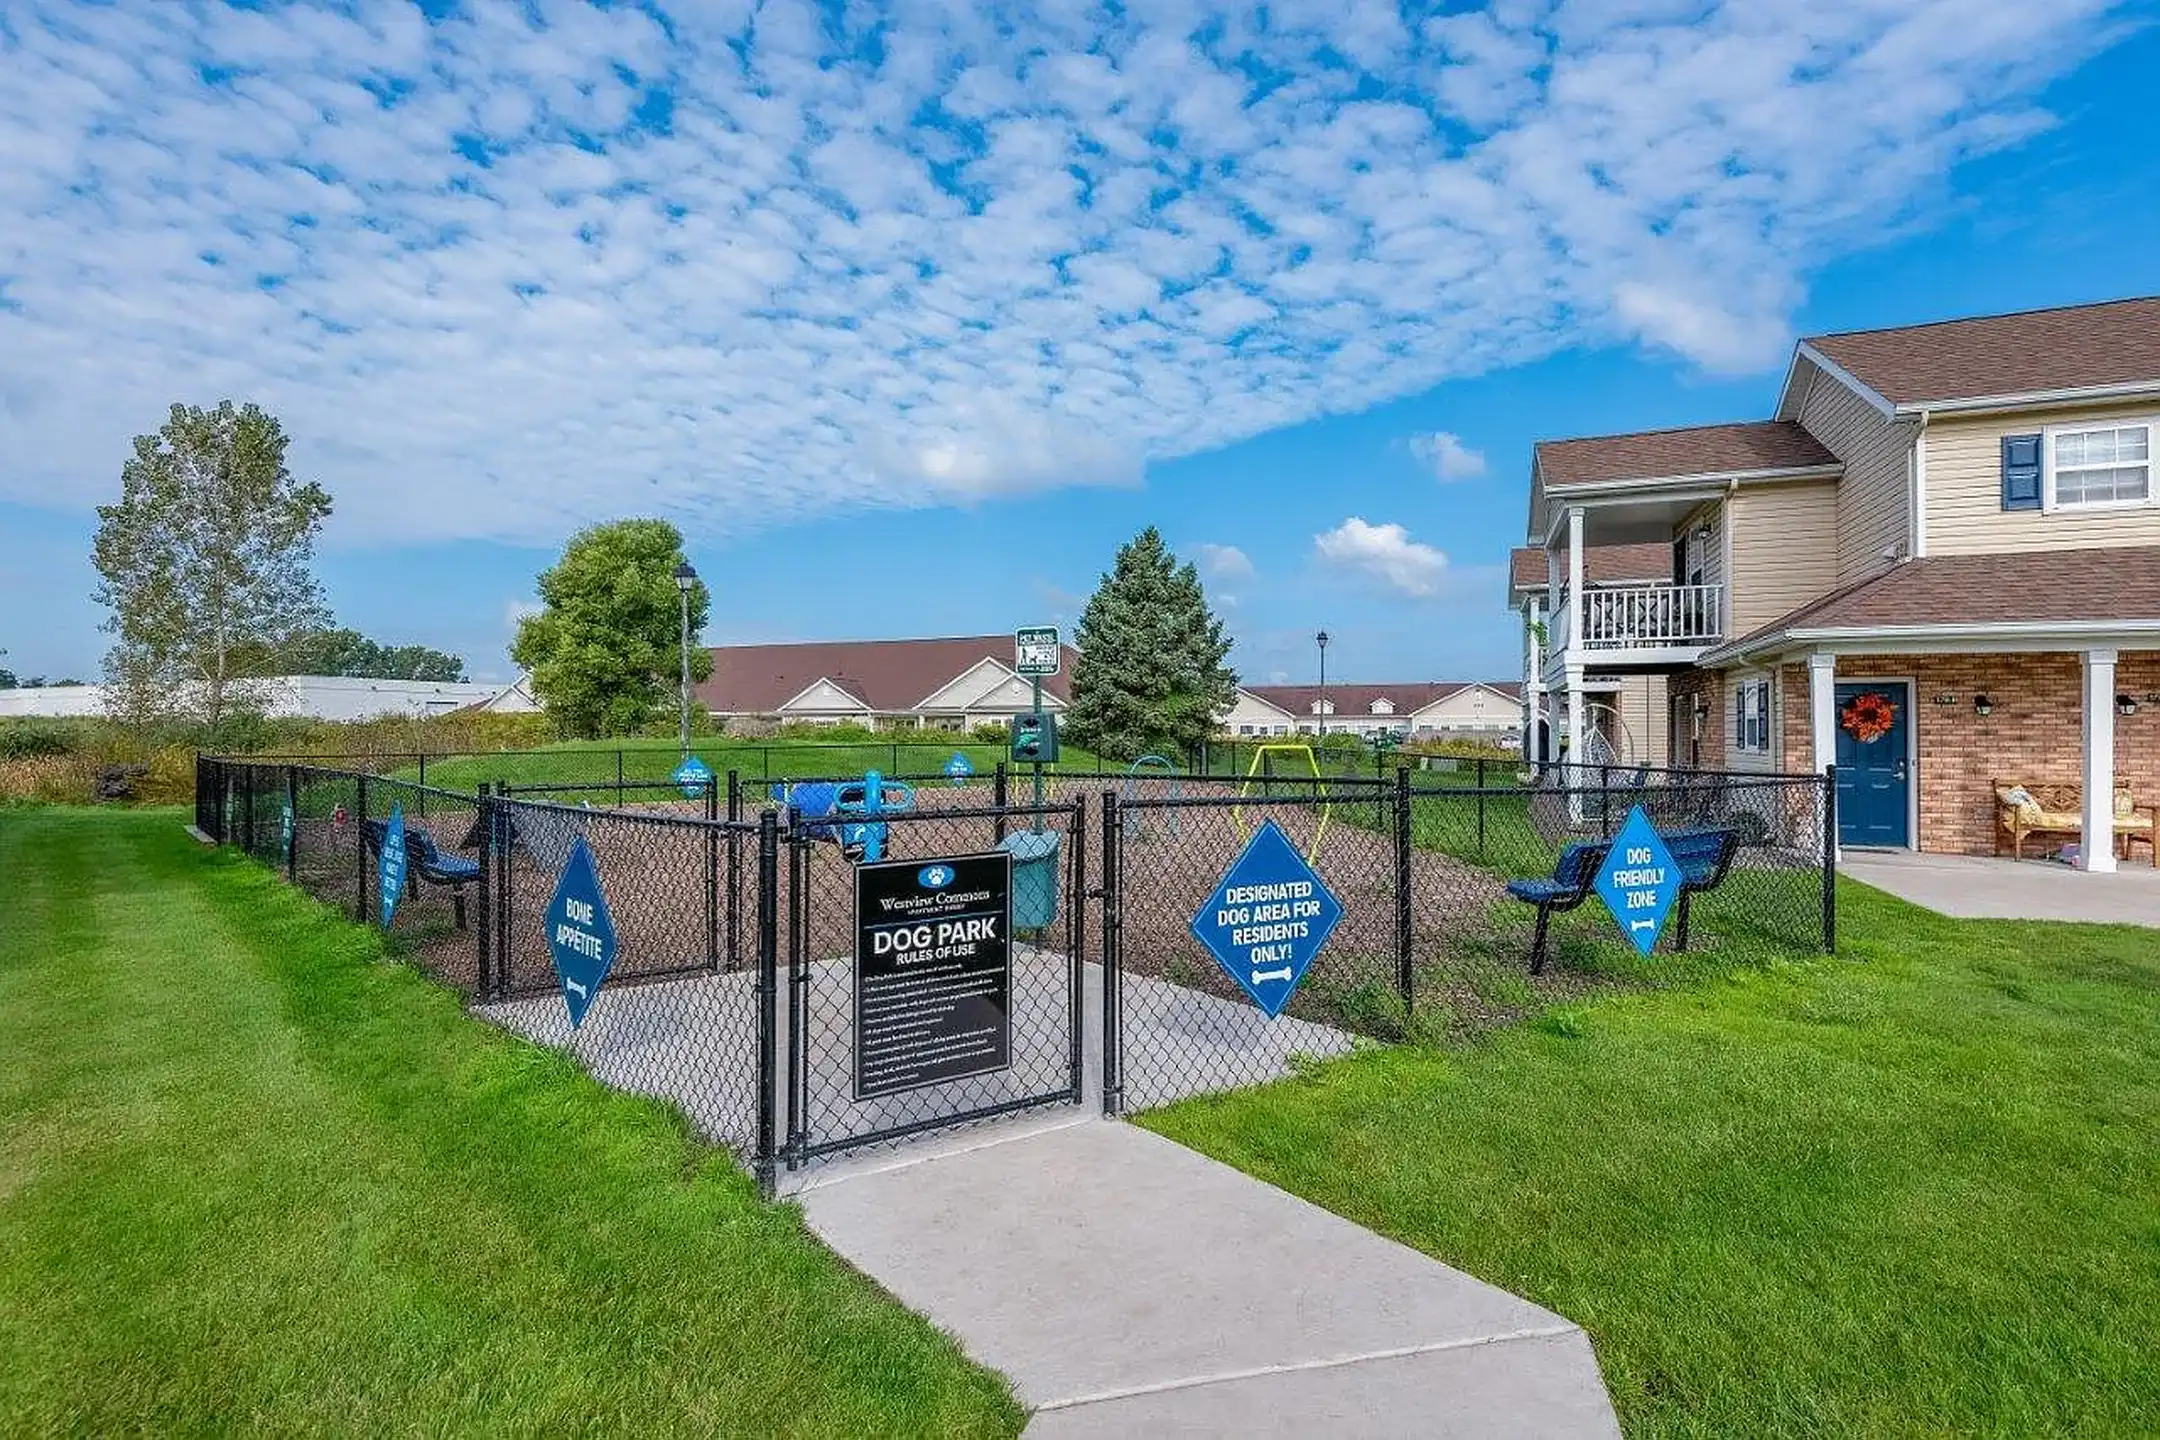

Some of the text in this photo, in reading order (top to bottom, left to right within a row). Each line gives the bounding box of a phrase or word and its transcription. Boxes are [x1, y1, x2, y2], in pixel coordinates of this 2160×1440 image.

[1627, 848, 1651, 865] DOG
[1613, 868, 1665, 888] FRIENDLY
[880, 895, 934, 911] Westview
[936, 890, 990, 904] Commons
[1226, 882, 1312, 904] DESIGNATED
[1626, 890, 1656, 909] ZONE
[566, 897, 593, 926] BONE
[1217, 900, 1321, 927] DOG AREA FOR
[874, 917, 996, 954] DOG PARK
[1233, 921, 1309, 945] RESIDENTS
[896, 943, 976, 966] RULES OF USE
[1251, 943, 1292, 964] ONLY!
